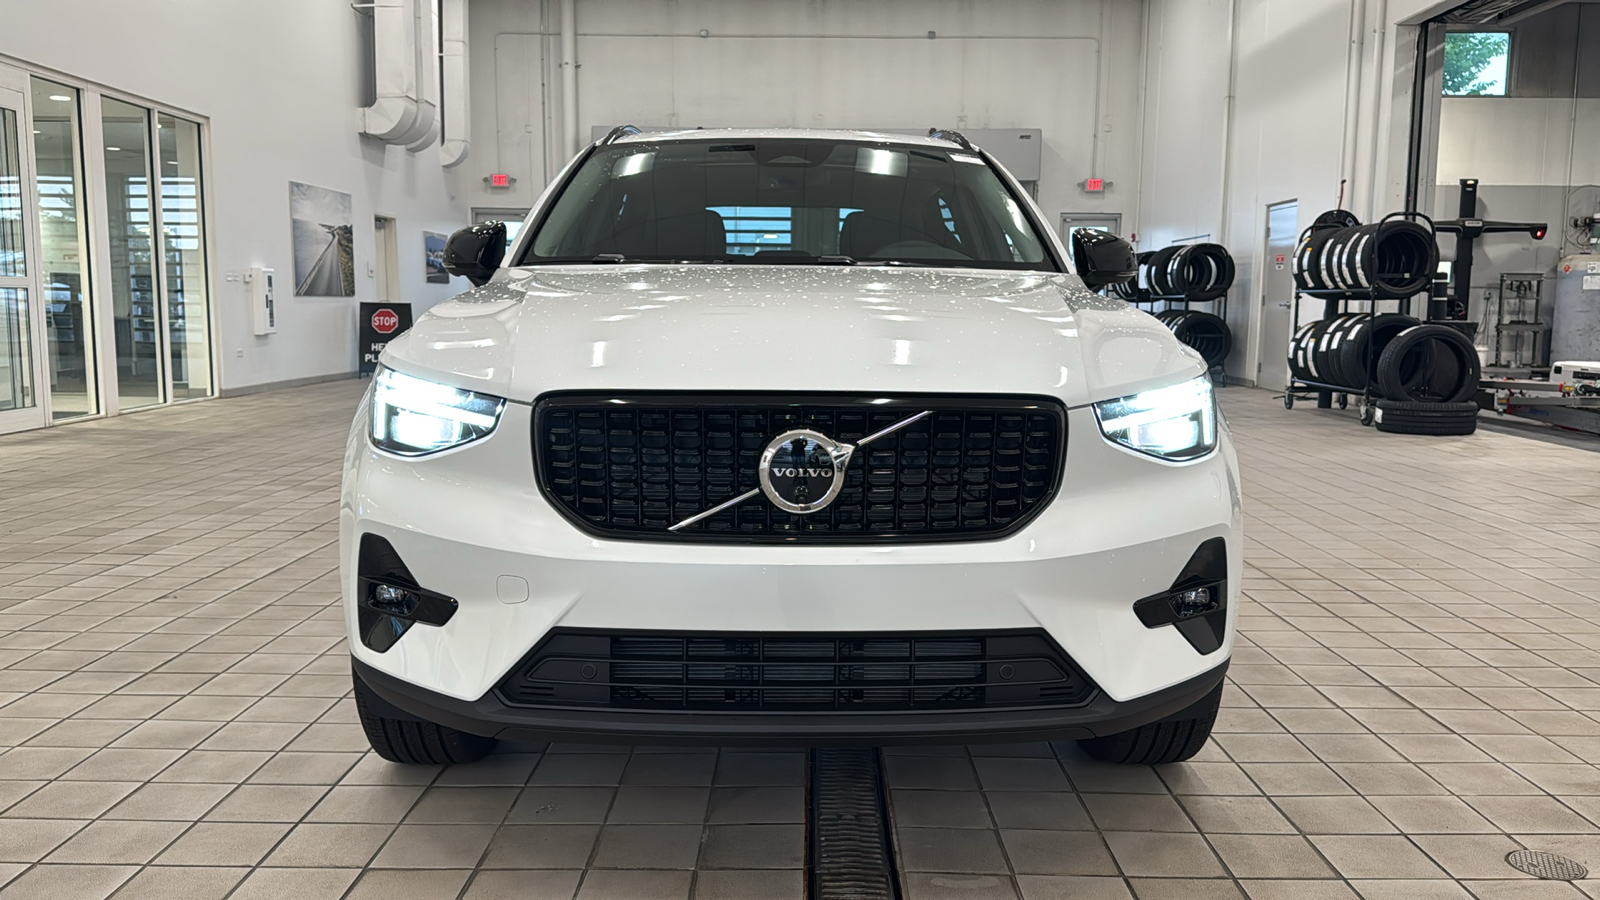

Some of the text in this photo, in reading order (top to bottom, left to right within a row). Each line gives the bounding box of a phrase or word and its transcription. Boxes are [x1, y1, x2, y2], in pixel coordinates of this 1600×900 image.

[374, 316, 396, 326] STOP
[364, 354, 380, 362] PL
[772, 467, 833, 477] VOLVO
